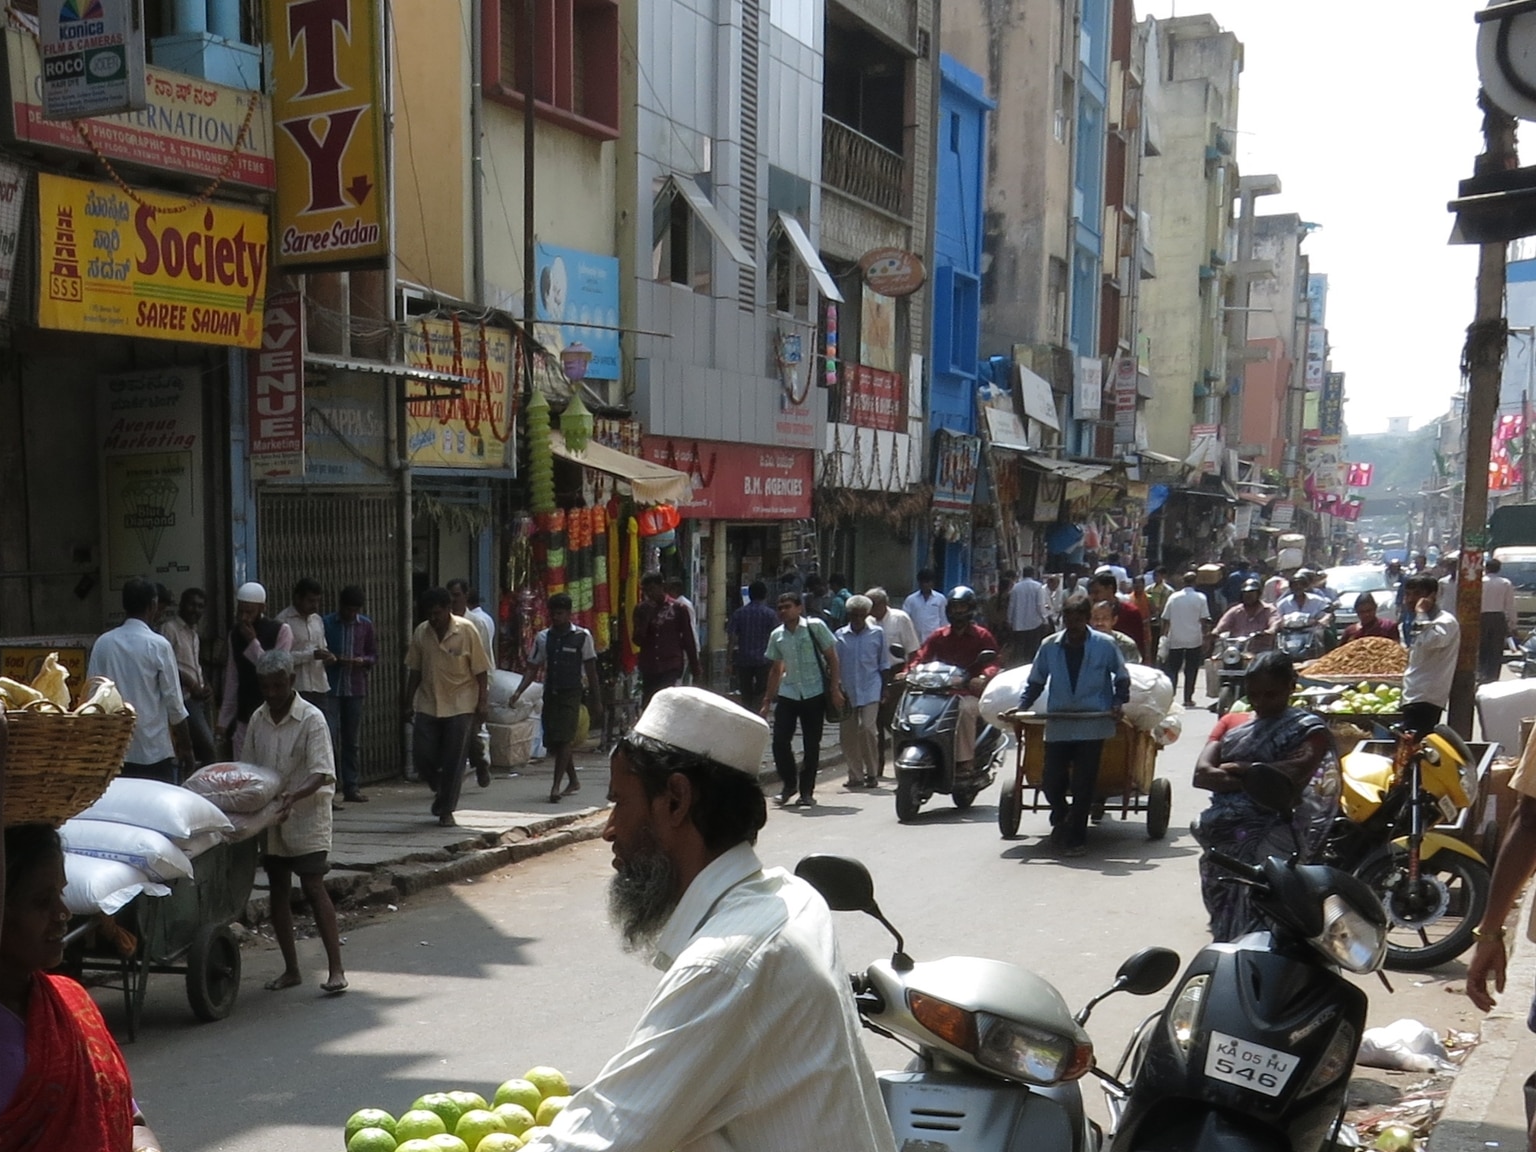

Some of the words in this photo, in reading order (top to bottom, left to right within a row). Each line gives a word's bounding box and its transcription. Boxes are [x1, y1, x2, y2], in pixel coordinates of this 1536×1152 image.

[58, 21, 105, 40] Konica
[44, 42, 66, 55] FILM
[67, 40, 75, 52] &
[76, 33, 124, 51] CAMERAS
[46, 58, 83, 77] ROCO
[179, 145, 234, 168] STATIONER
[237, 157, 265, 175] ITEMS
[281, 227, 328, 254] Saree
[330, 219, 379, 248] Sadan
[134, 203, 266, 315] Society
[135, 300, 188, 331] SAREE
[191, 306, 242, 337] SADAN
[256, 306, 298, 439] AVENUE
[110, 417, 178, 434] Avenue
[104, 431, 197, 450] Marketing
[252, 437, 301, 452] Marketing
[764, 476, 804, 497] AGENCIES
[1217, 1042, 1237, 1058] KA
[1241, 1052, 1263, 1065] 05
[1265, 1058, 1288, 1073] HJ
[1215, 1058, 1279, 1089] 546
